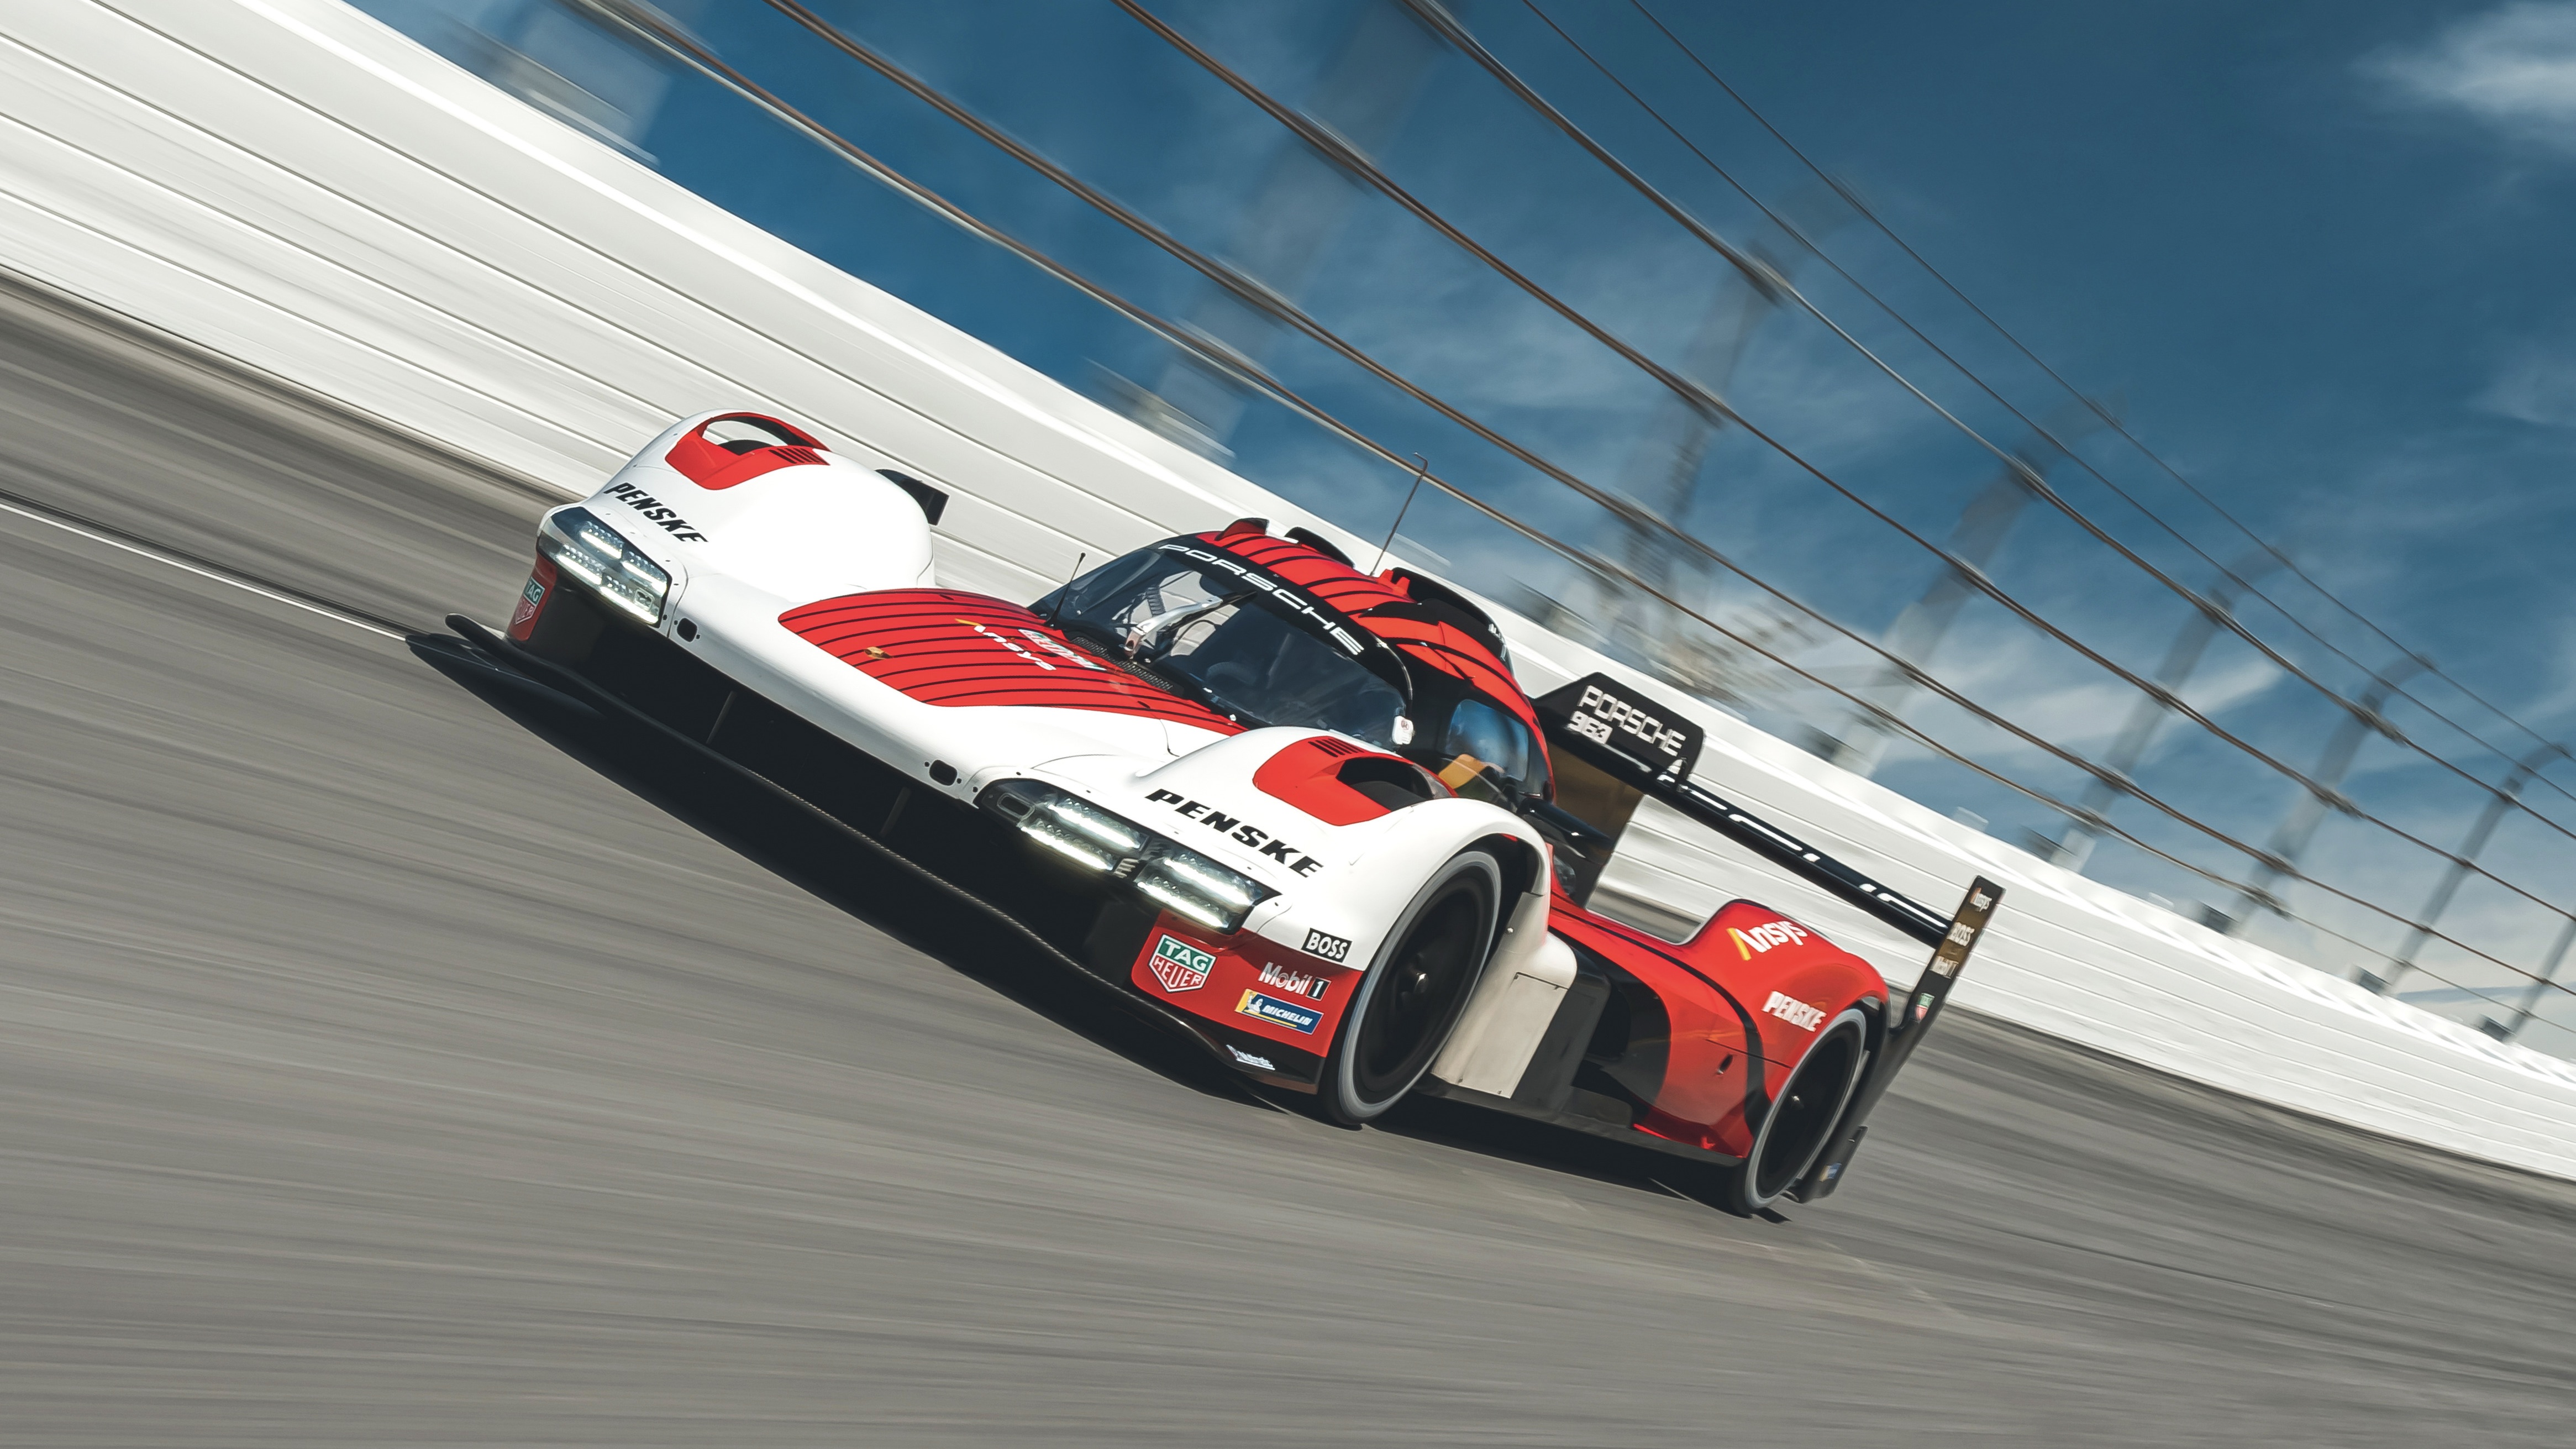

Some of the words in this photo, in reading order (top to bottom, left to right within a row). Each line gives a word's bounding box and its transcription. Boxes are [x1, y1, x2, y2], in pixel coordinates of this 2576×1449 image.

[603, 482, 708, 542] PENSKE
[1158, 544, 1364, 655] PORSCHE
[1578, 685, 1686, 757] PORSCHE
[1144, 789, 1324, 878] PENSKE
[1165, 940, 1209, 971] TAG
[1306, 932, 1348, 959] BOSS
[1726, 921, 1808, 960] Ansys
[1154, 957, 1202, 988] HEUER
[1258, 962, 1313, 995] Mobil
[1262, 1005, 1313, 1026] MICHELIN
[1761, 990, 1827, 1032] PENSKE
